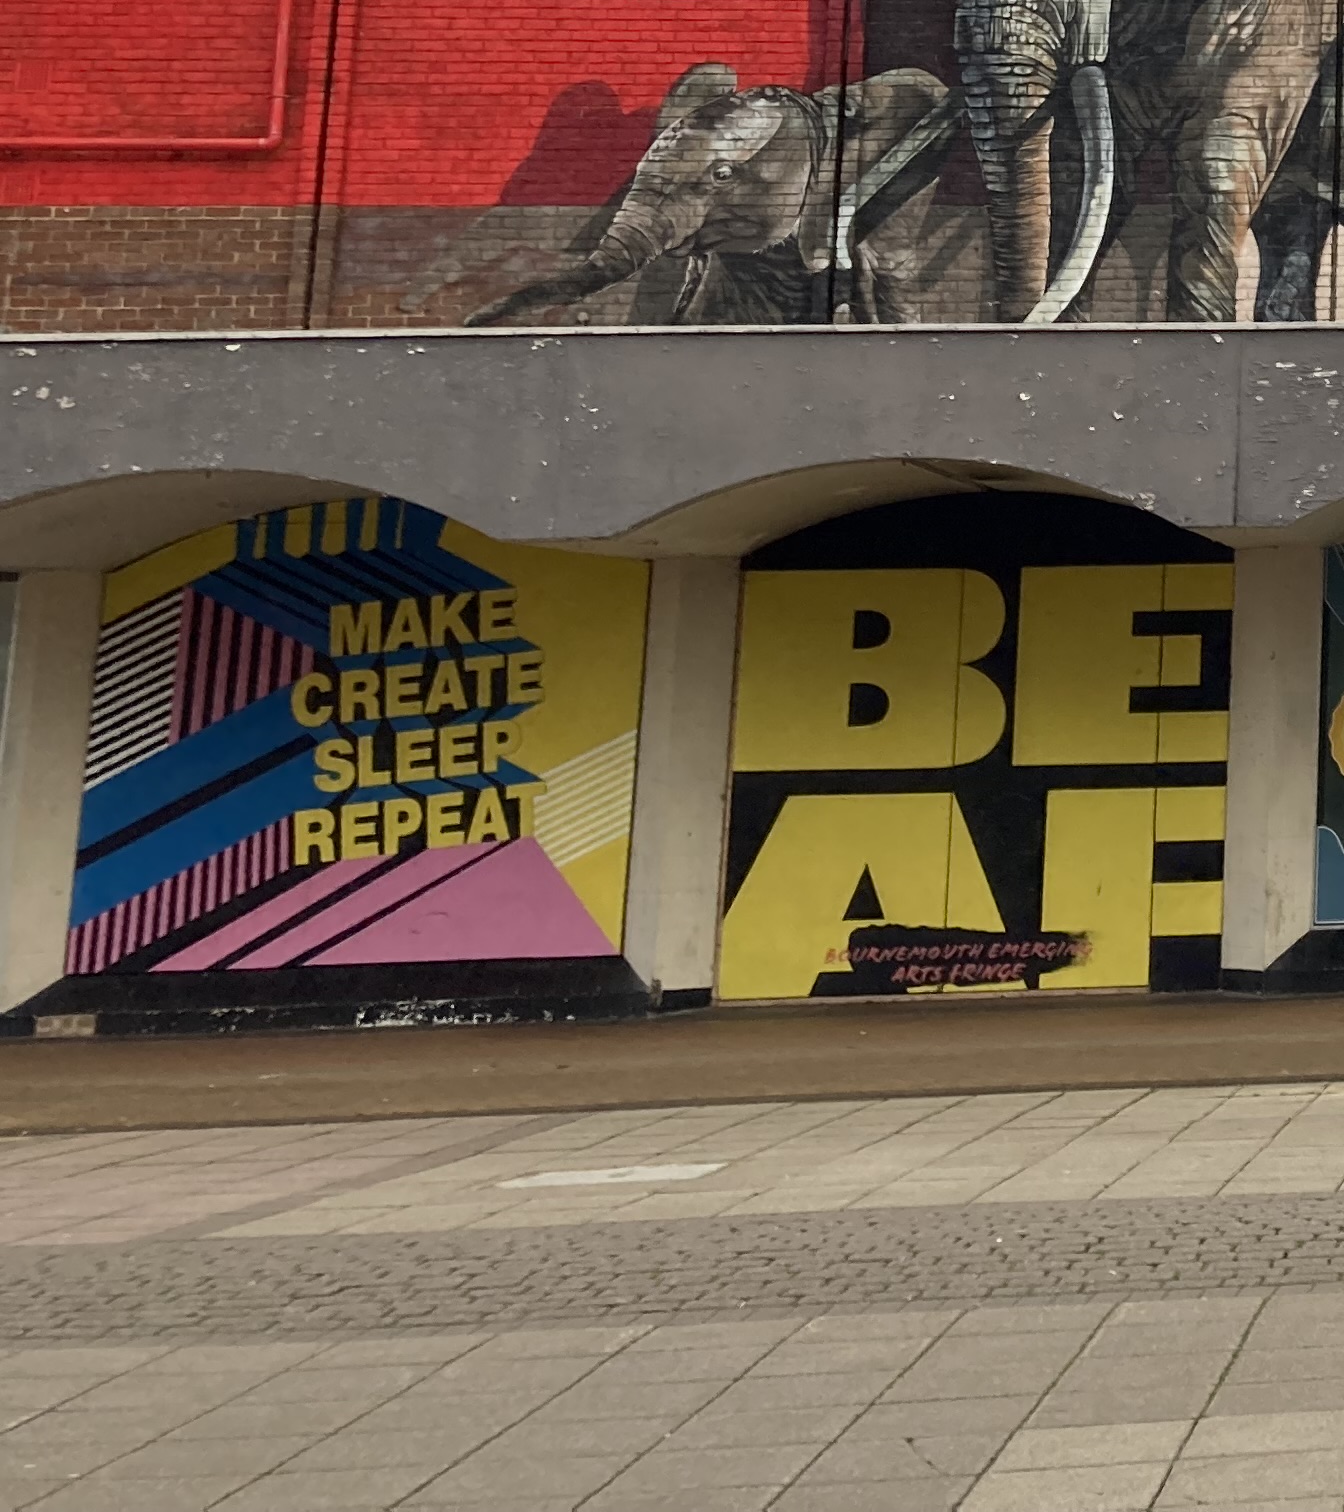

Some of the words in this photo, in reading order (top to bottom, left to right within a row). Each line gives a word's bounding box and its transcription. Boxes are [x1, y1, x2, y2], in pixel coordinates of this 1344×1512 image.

[330, 588, 517, 657] MAKE
[291, 649, 545, 728] CREATE
[732, 562, 1235, 772] BE
[313, 720, 522, 793] SLEEP
[294, 781, 547, 865] REPEAT
[824, 943, 984, 965] BOURNEMOUTH
[890, 964, 943, 984] ARTS
[948, 963, 1027, 984] FRINGE
